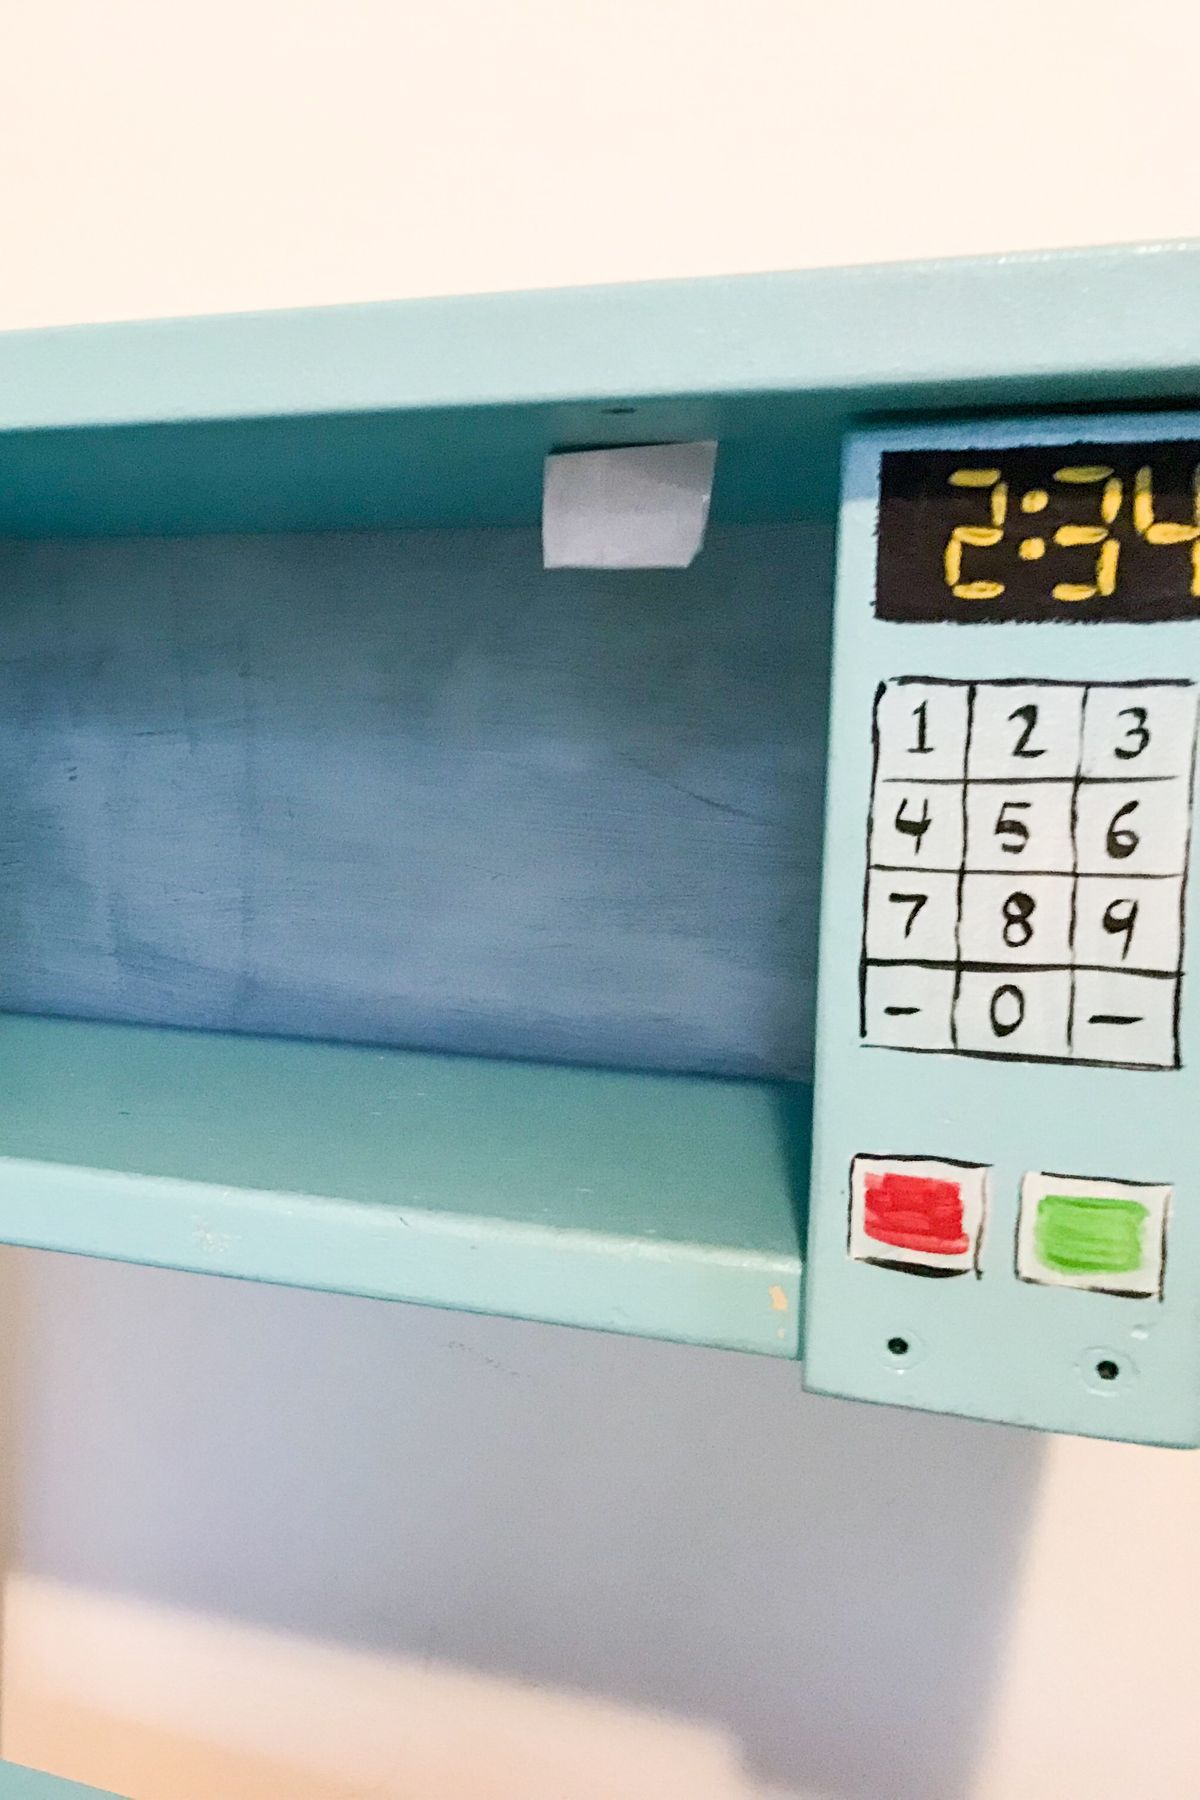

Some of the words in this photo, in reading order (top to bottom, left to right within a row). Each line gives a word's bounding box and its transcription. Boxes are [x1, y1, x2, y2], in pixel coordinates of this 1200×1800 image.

[944, 465, 1200, 601] 2:34
[907, 700, 934, 753] 1
[1008, 704, 1048, 758] 2
[1114, 707, 1150, 759] 3
[895, 798, 932, 854] 4
[995, 802, 1031, 853] 5
[1106, 800, 1139, 859] 6
[889, 892, 928, 938] 7
[1003, 891, 1035, 947] 8
[1103, 899, 1138, 960] 9
[990, 984, 1025, 1037] 0
